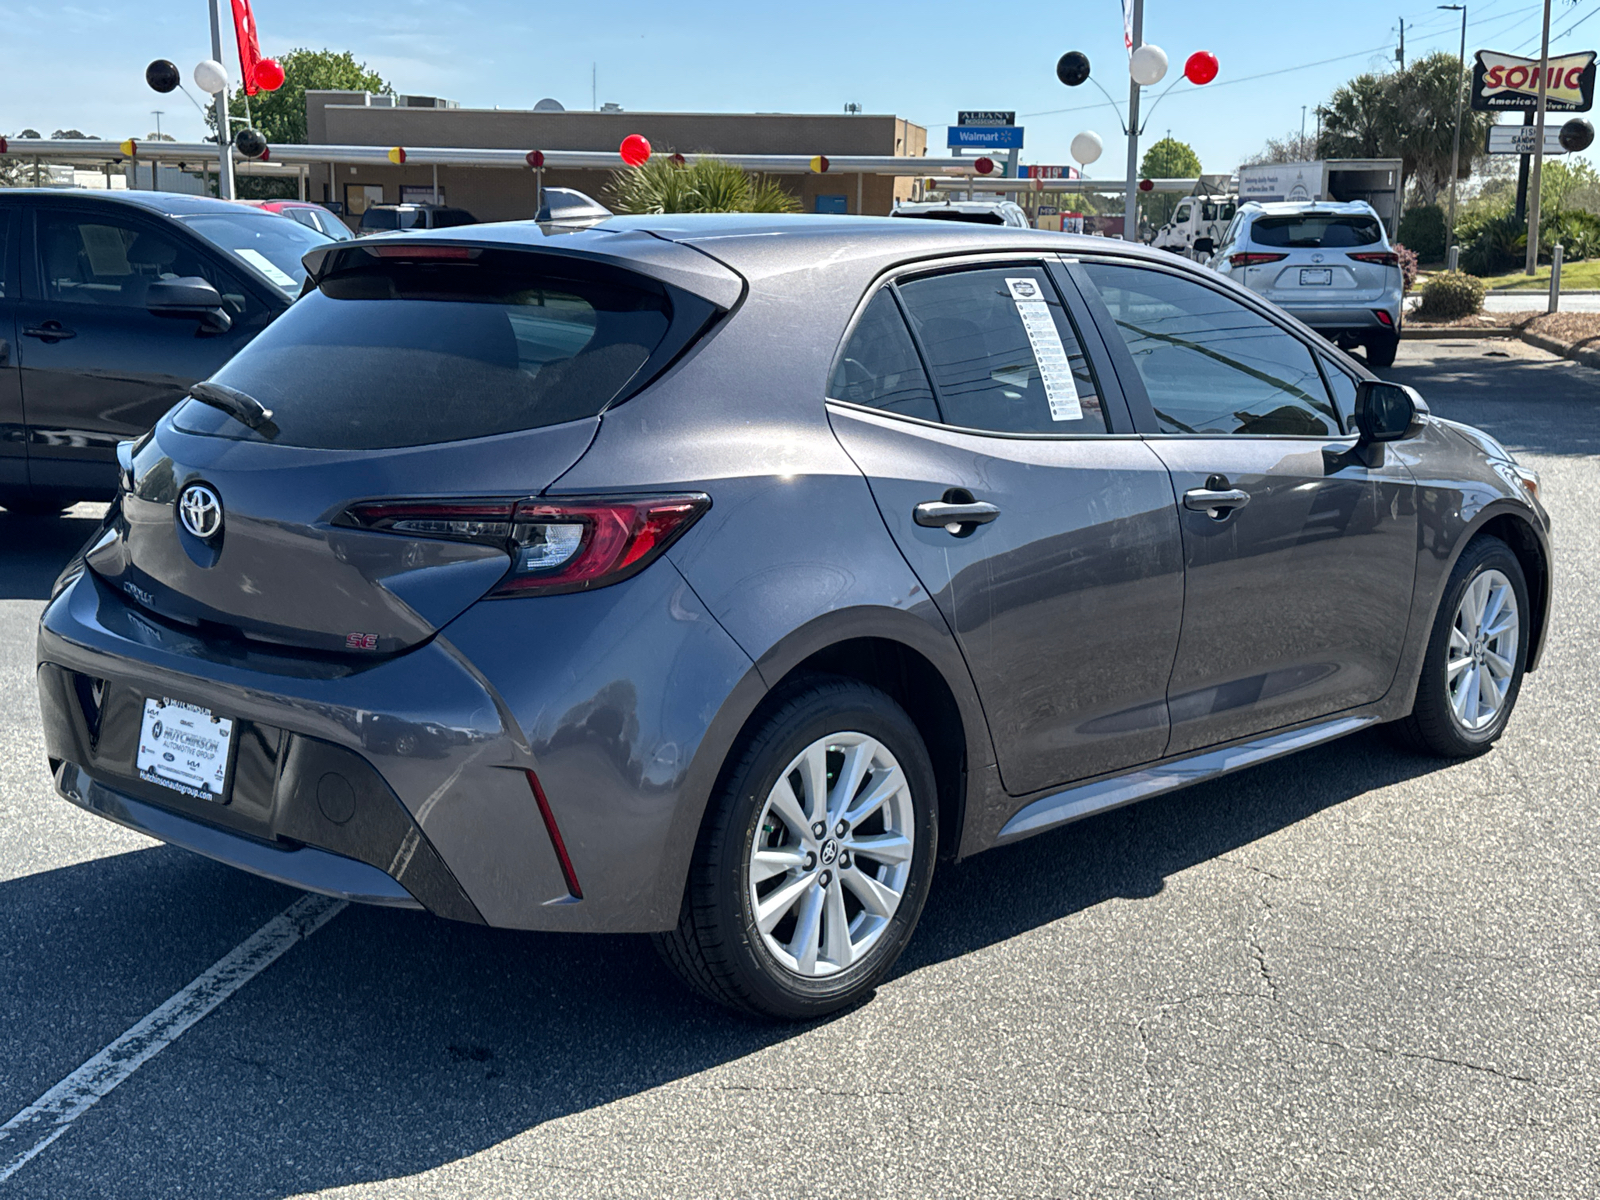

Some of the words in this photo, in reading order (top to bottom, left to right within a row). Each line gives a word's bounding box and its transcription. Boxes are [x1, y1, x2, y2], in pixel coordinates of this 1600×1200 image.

[1486, 65, 1584, 89] SONIC
[1488, 97, 1537, 105] America's
[959, 131, 999, 141] Walmart
[345, 632, 378, 650] SE
